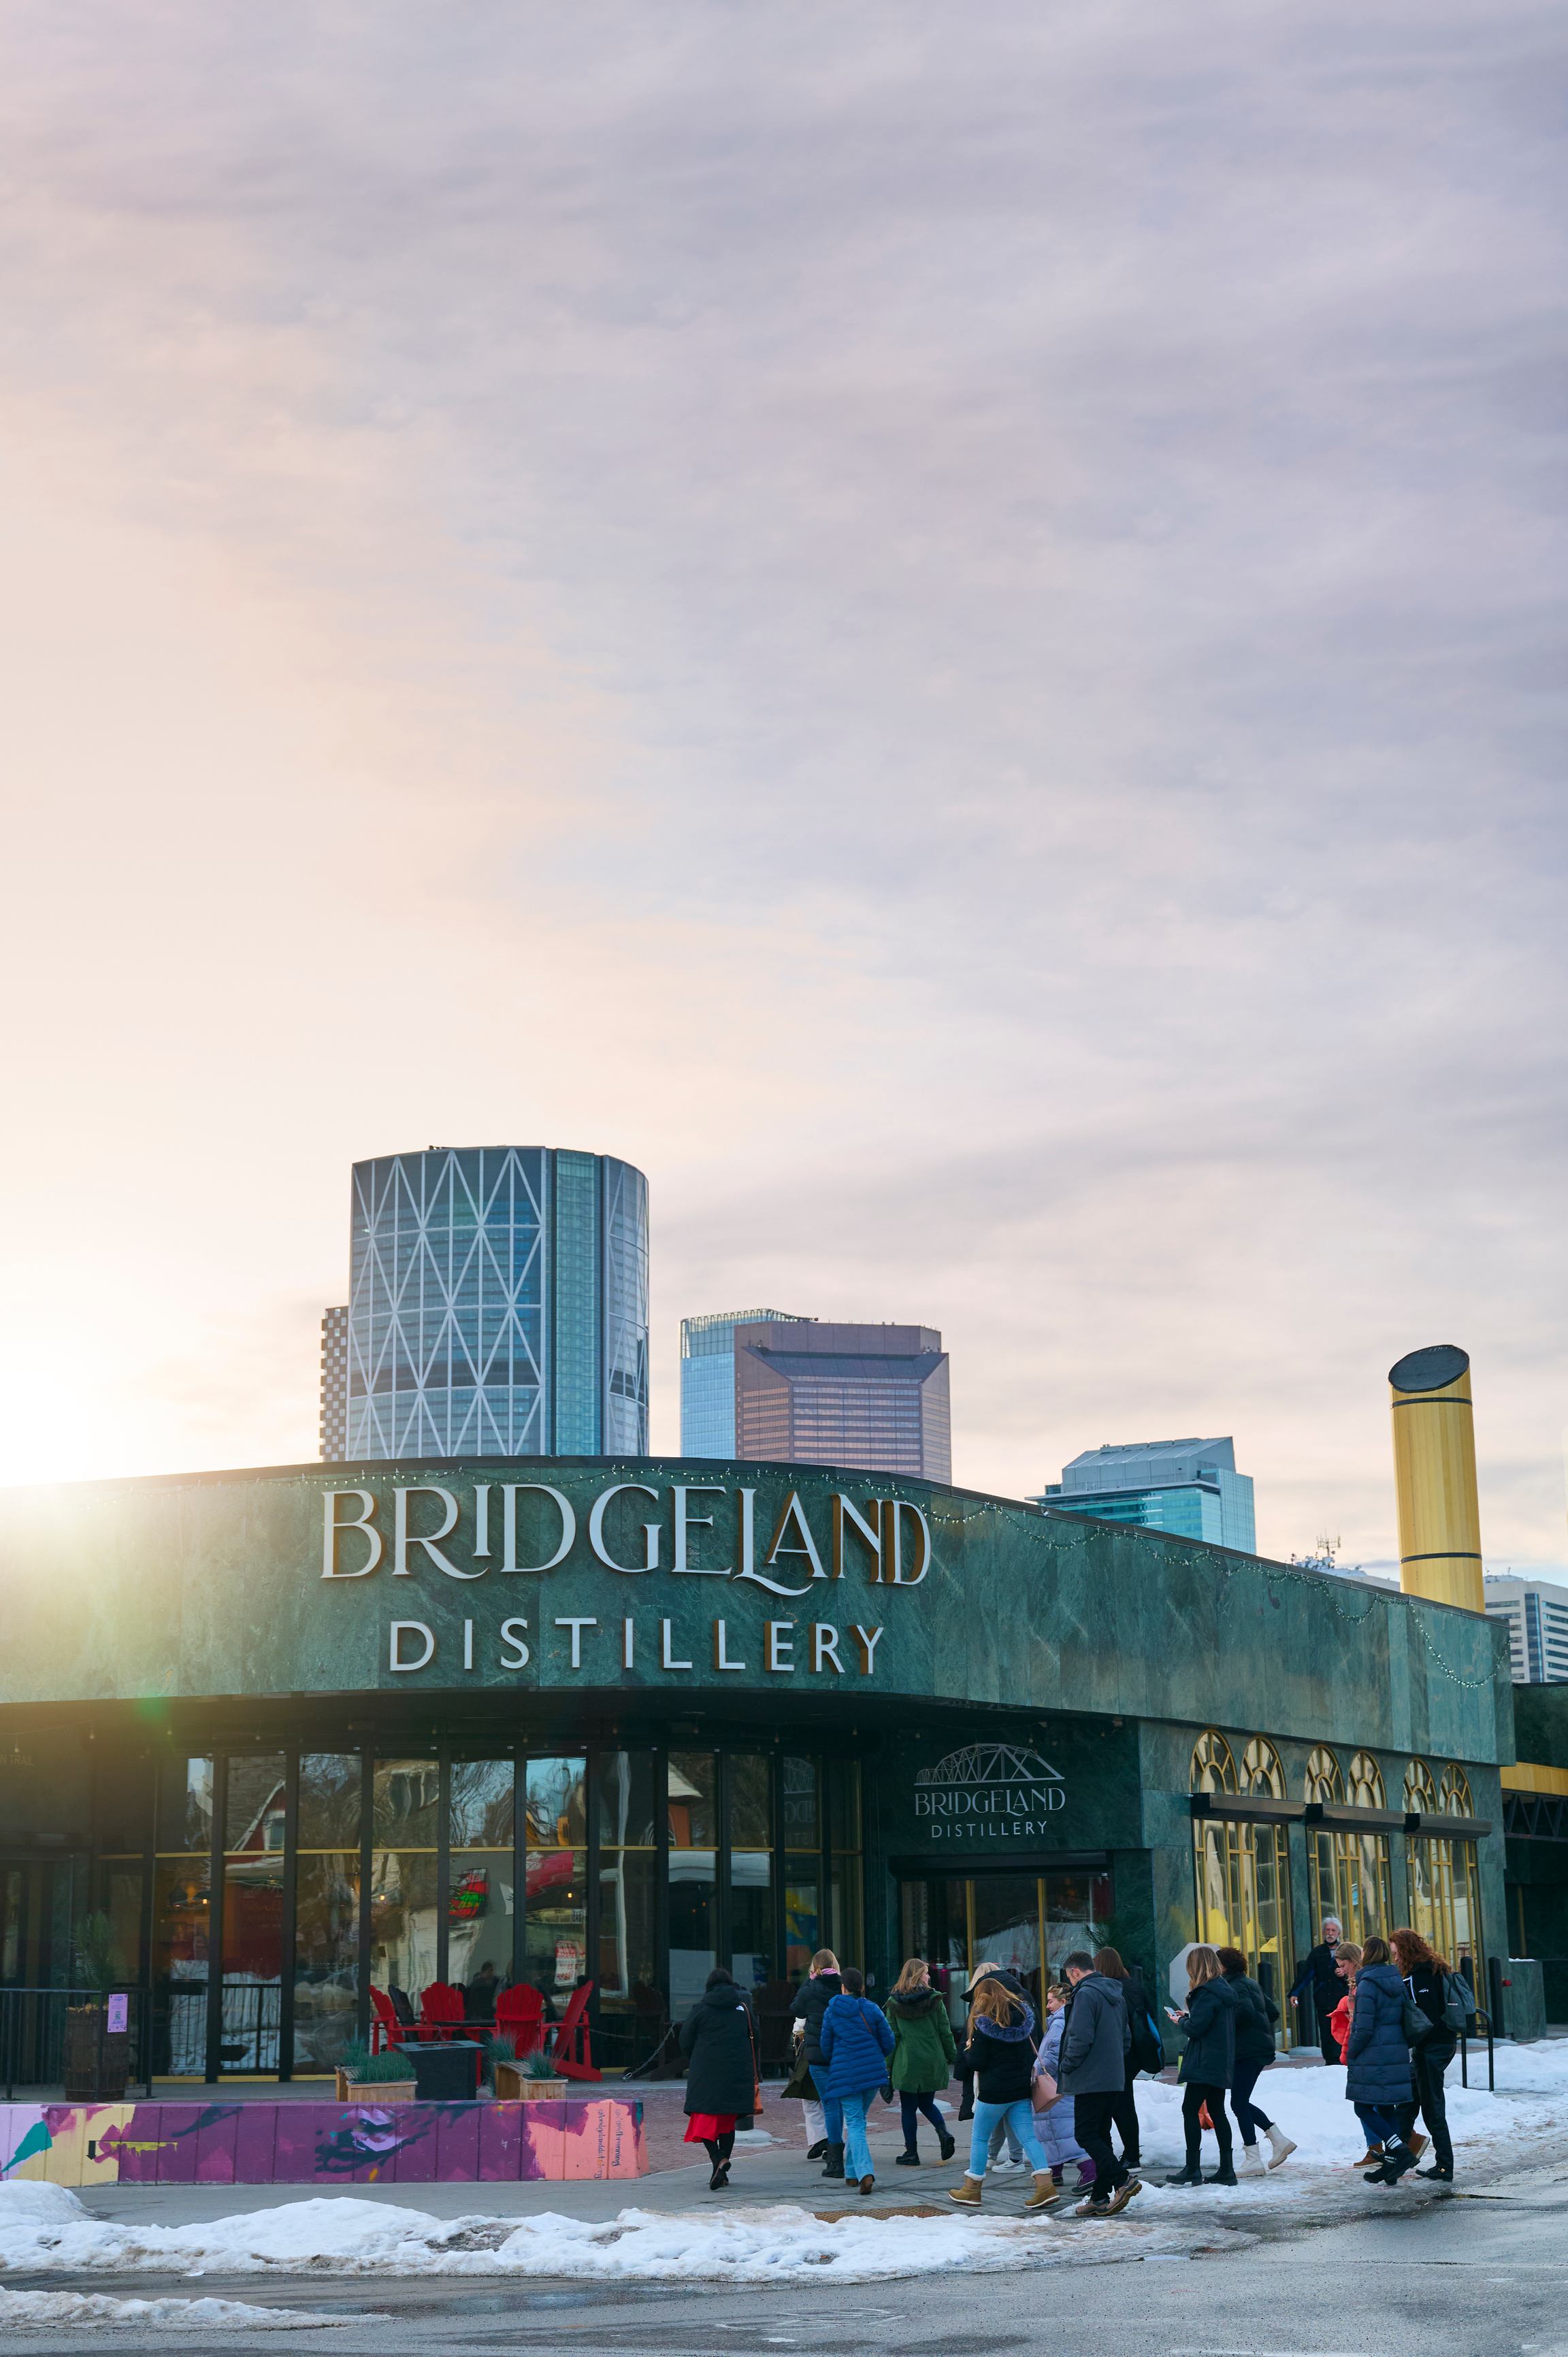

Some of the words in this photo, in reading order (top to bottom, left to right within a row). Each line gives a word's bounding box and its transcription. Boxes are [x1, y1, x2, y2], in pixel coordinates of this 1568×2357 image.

[320, 1482, 933, 1597] BRIDGELAND
[389, 1616, 885, 1675] DISTILLERY
[915, 1787, 1066, 1817] BRIDGELAND
[931, 1821, 1047, 1838] DISTILLERY
